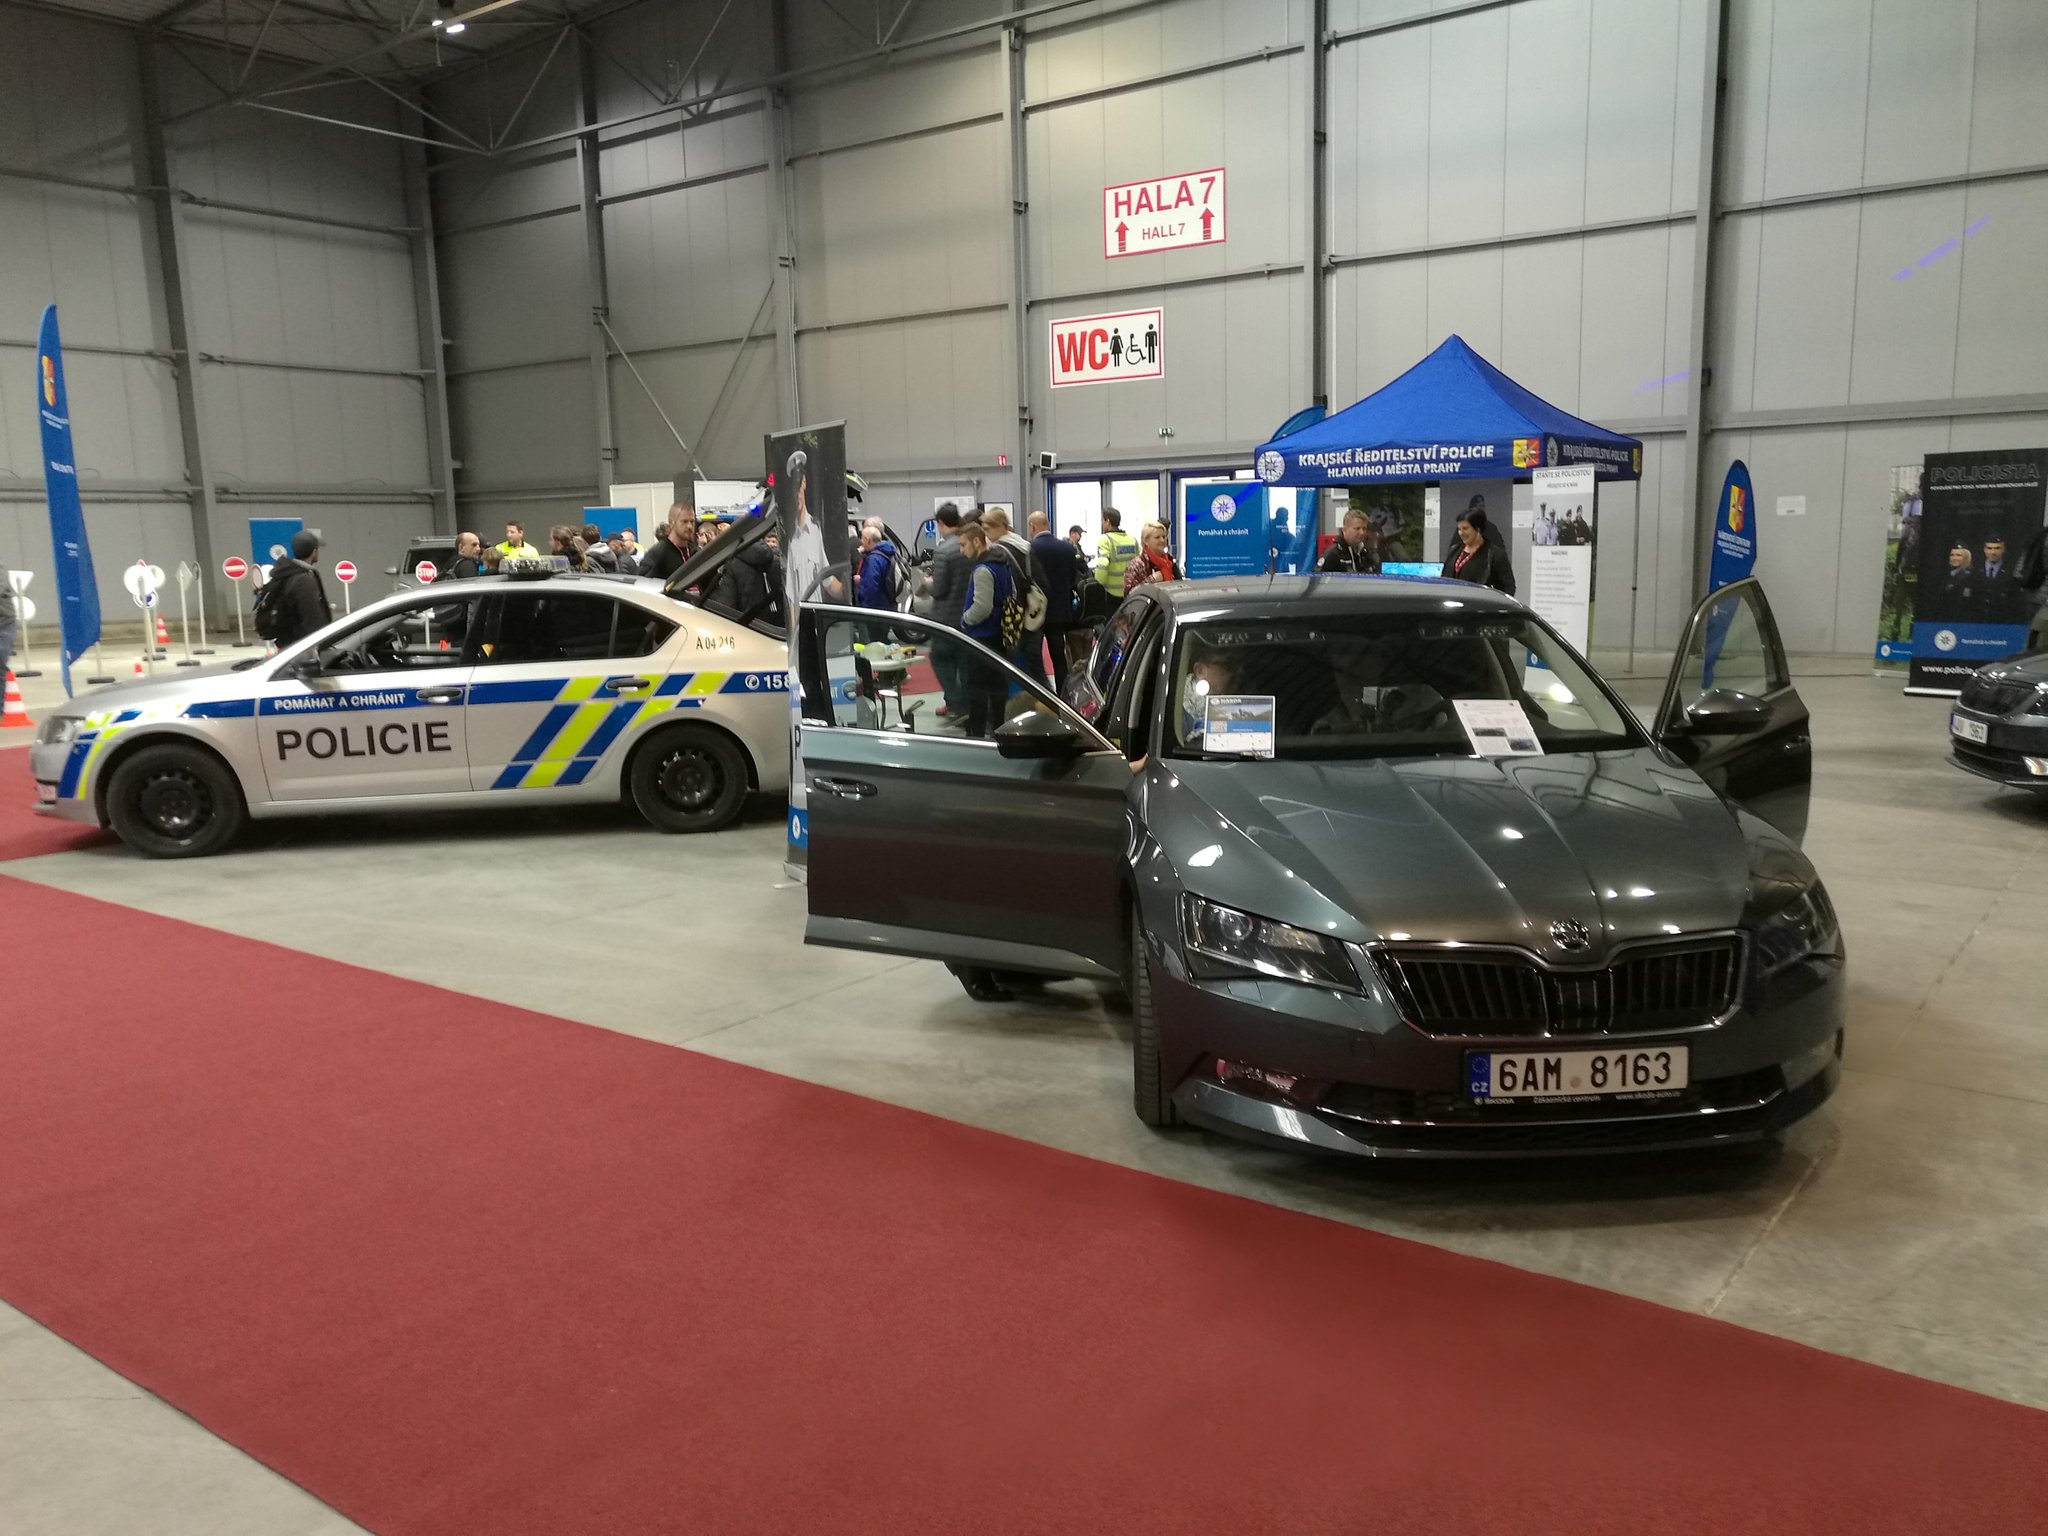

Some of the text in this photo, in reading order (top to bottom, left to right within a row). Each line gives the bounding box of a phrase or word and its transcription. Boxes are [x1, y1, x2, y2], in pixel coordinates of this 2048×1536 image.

[1114, 176, 1216, 218] HALA 7
[1142, 223, 1186, 240] HALL 7
[1057, 328, 1110, 373] WC
[1299, 445, 1494, 469] KRAJSKÉ ŘEDITELSTVÍ POLICIE
[1327, 461, 1462, 478] HLAVNÍHO MĚSTA PRAHY
[1930, 464, 2041, 483] POLICISTA
[1198, 528, 1223, 536] Pomáhat
[1229, 528, 1249, 536] chránit
[419, 567, 436, 578] STOP
[696, 636, 704, 650] A
[706, 637, 716, 650] 04
[763, 674, 789, 689] 158
[274, 692, 405, 711] POMÁHAT A CHRÁNIT
[275, 721, 451, 760] POLICIE
[1499, 1051, 1671, 1092] 6AM 8163
[1472, 1082, 1489, 1093] CZ
